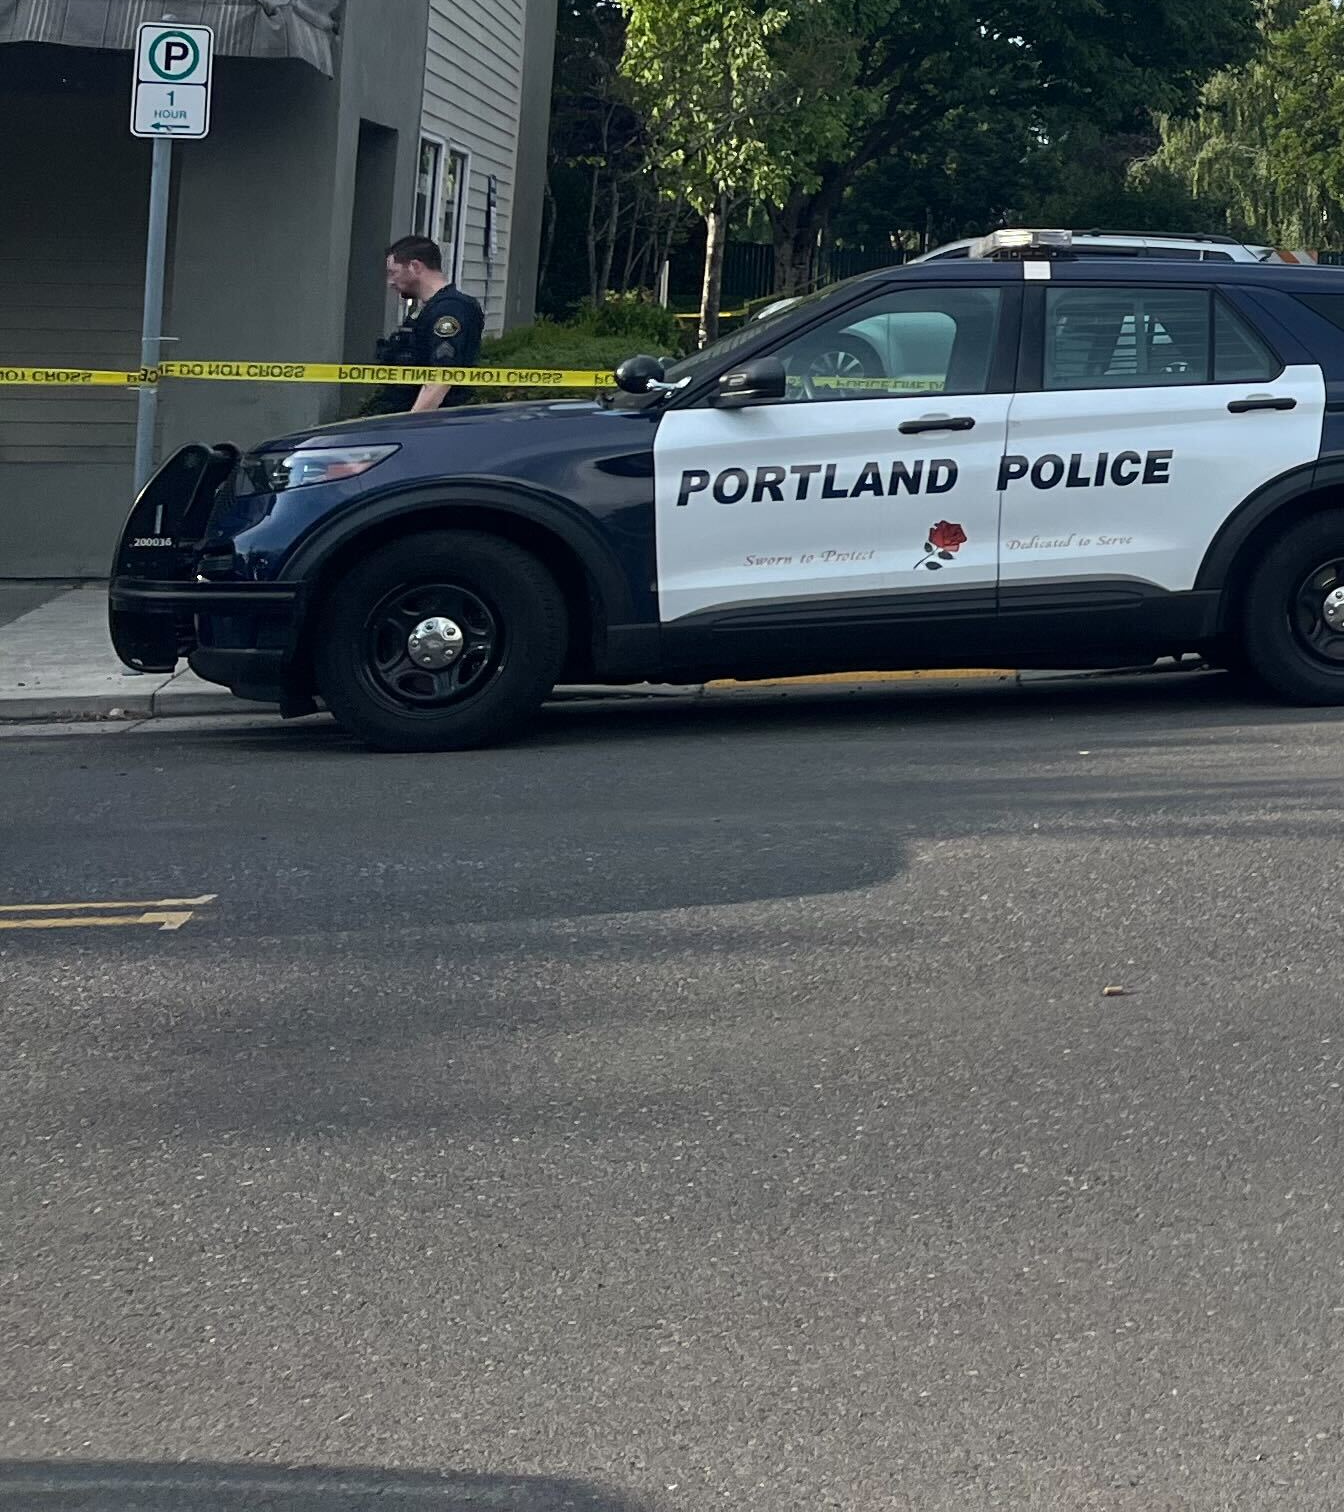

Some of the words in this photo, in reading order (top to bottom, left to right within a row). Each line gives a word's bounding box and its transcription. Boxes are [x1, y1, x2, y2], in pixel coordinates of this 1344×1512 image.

[164, 41, 189, 71] P
[166, 90, 175, 106] 1
[154, 110, 187, 119] HOUR
[676, 458, 958, 506] PORTLAND
[997, 449, 1174, 491] POLICE
[1006, 533, 1077, 550] Dedicated
[1079, 537, 1091, 547] to
[1096, 535, 1133, 546] Serve
[743, 554, 793, 566] Sworn
[800, 553, 815, 564] to
[820, 549, 876, 562] Protect
